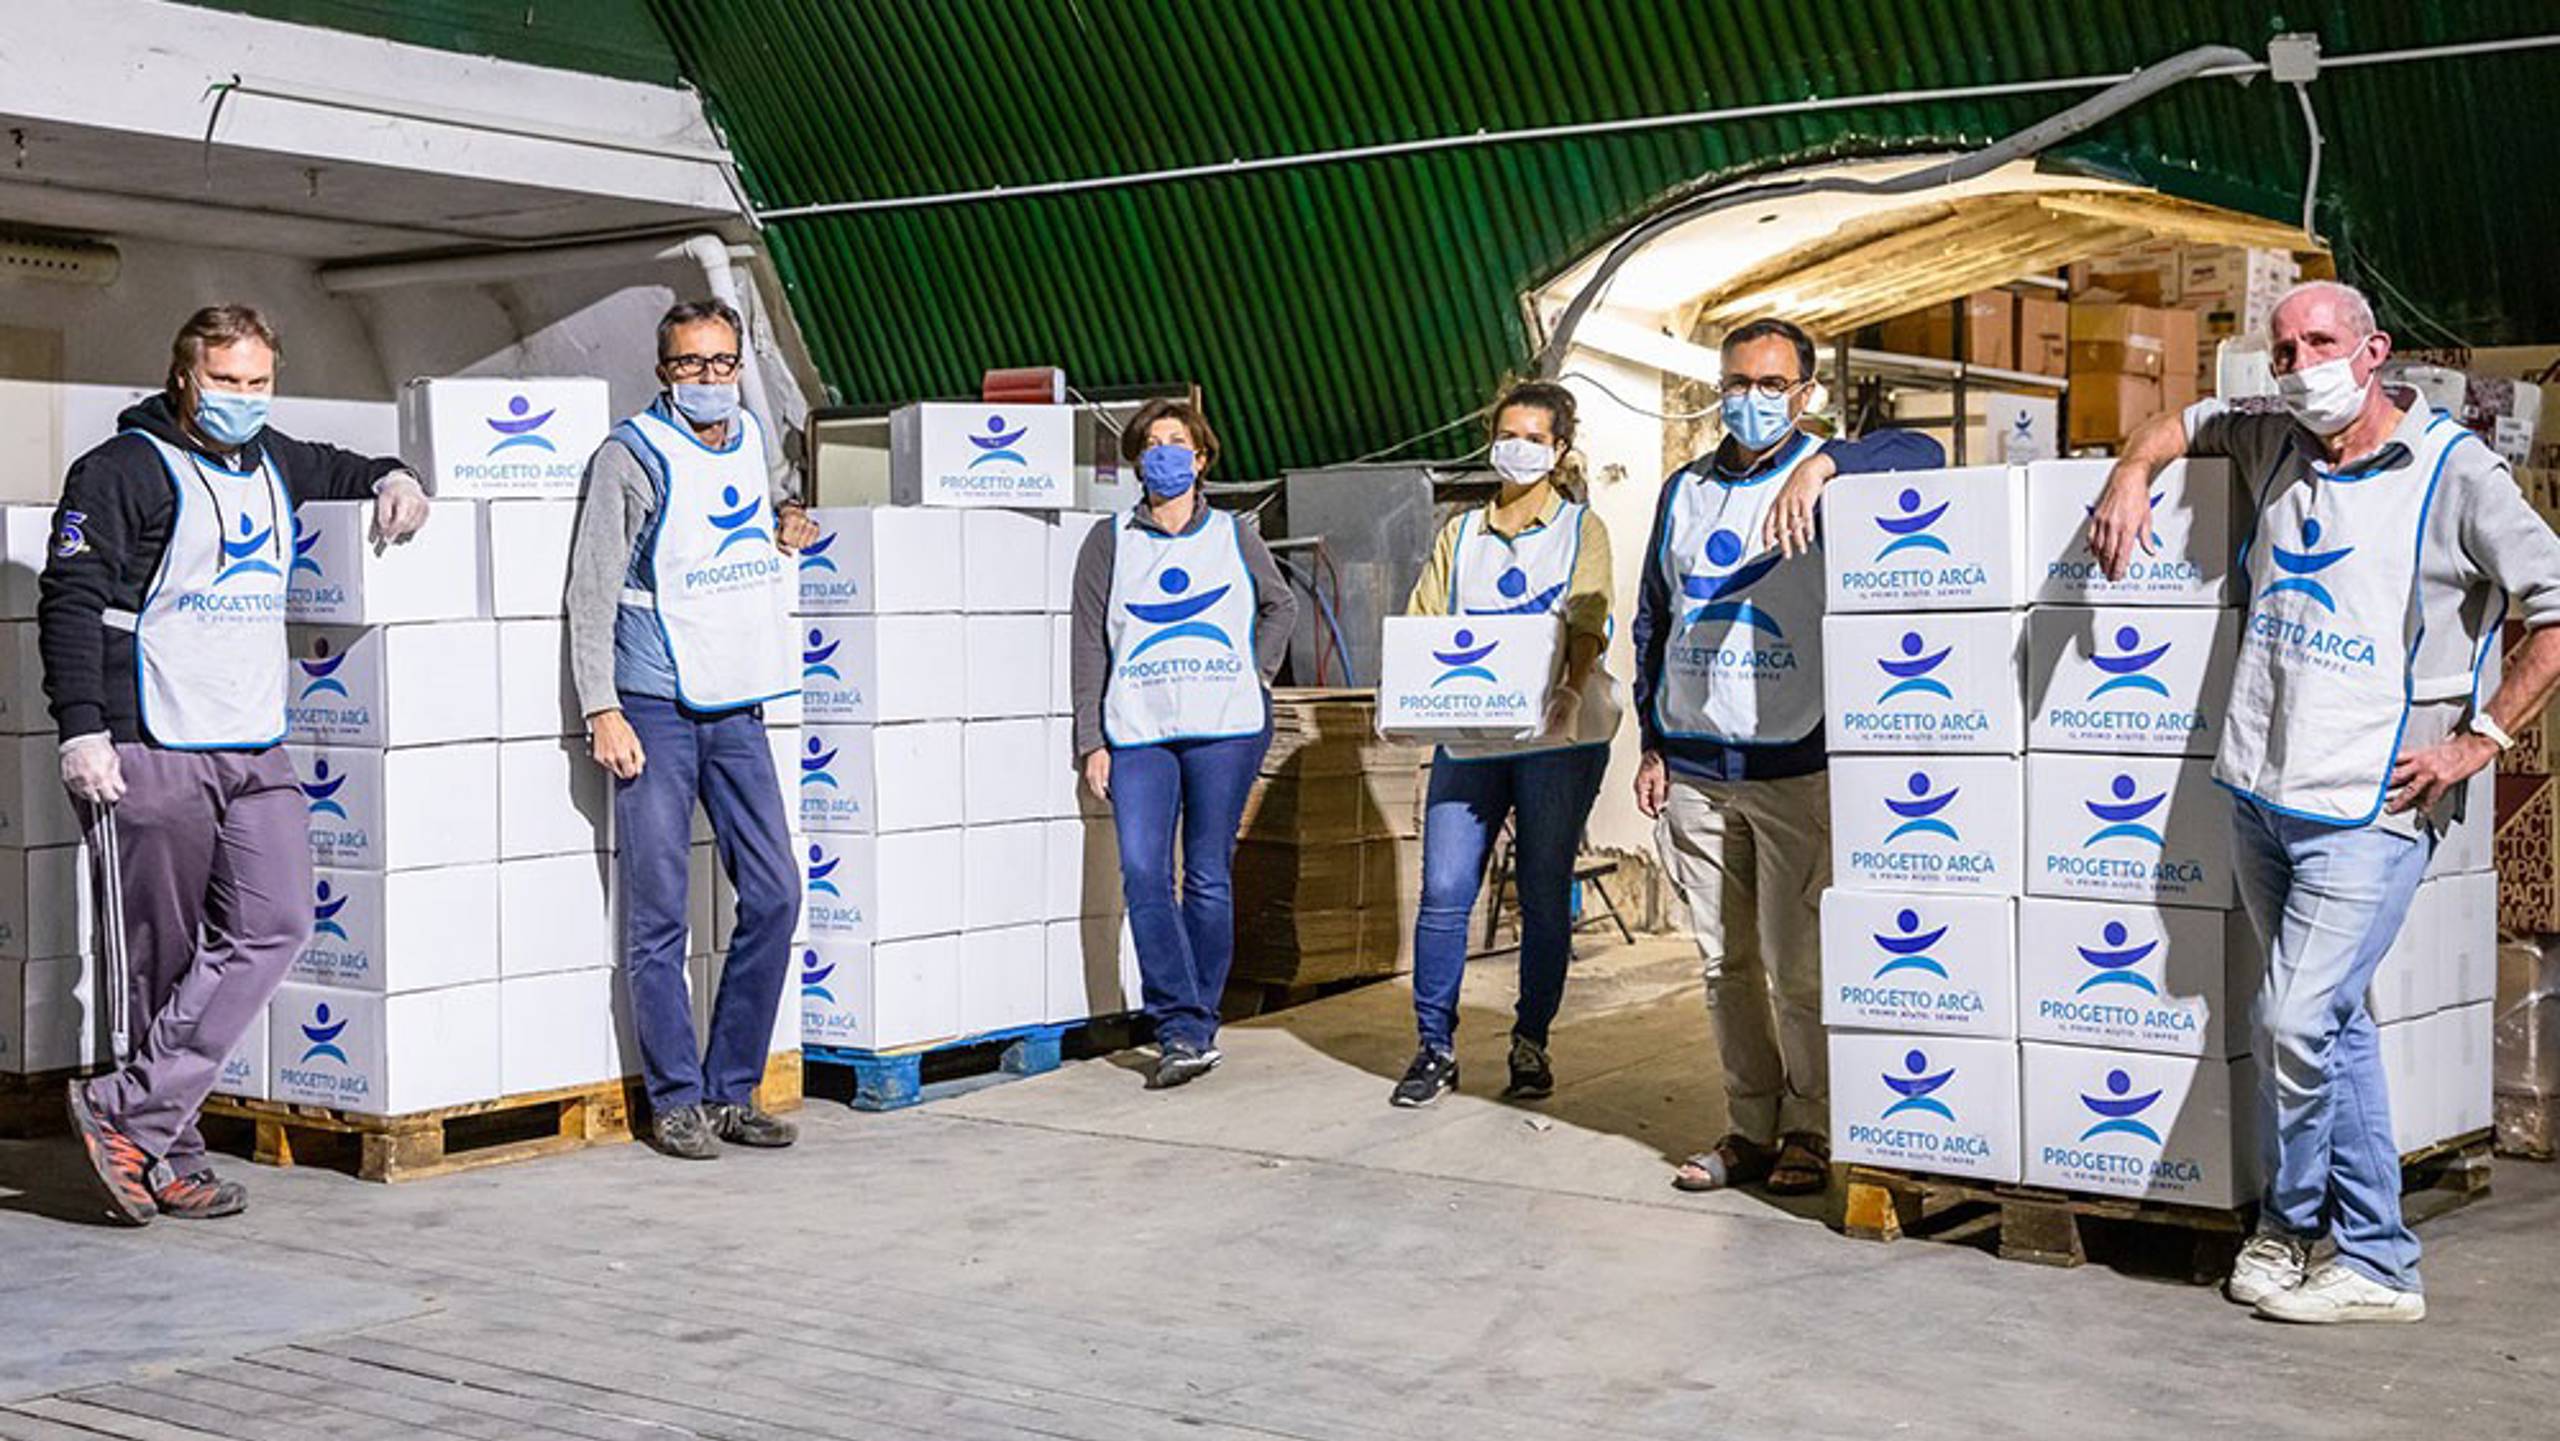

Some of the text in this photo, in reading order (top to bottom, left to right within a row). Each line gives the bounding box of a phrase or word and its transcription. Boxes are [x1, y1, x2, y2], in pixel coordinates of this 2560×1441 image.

[455, 464, 541, 479] PROGETTO
[940, 476, 1055, 489] PROGETTO ARCA
[686, 559, 767, 589] PROGETTO
[1843, 568, 1987, 589] PROGETTO ARCA
[2048, 563, 2201, 579] PROGO ARCA
[829, 582, 857, 597] ARCA
[178, 594, 272, 612] PROGETTO
[2307, 629, 2376, 666] ARCA
[1118, 658, 1202, 679] PROGETTO
[1741, 650, 1797, 669] ARCA
[831, 690, 861, 705] ARCA
[1400, 694, 1527, 709] PROGETTO ARCA
[1845, 713, 1988, 731] PROGETTO ARCA
[2050, 710, 2208, 731] PROGETTO ARCA
[1852, 851, 1995, 873] PROGETTO ARCA
[2047, 855, 2203, 882] PROGETTO ARCA
[1841, 986, 1984, 1012] PROGETTO ARCA
[2040, 1000, 2195, 1031] PROGETTO ARCA
[281, 1068, 369, 1095] PROGETTO ARCA
[1850, 1126, 1990, 1157] PROGETTO ARCA
[2043, 1147, 2201, 1182] PROGETTO ARCA
